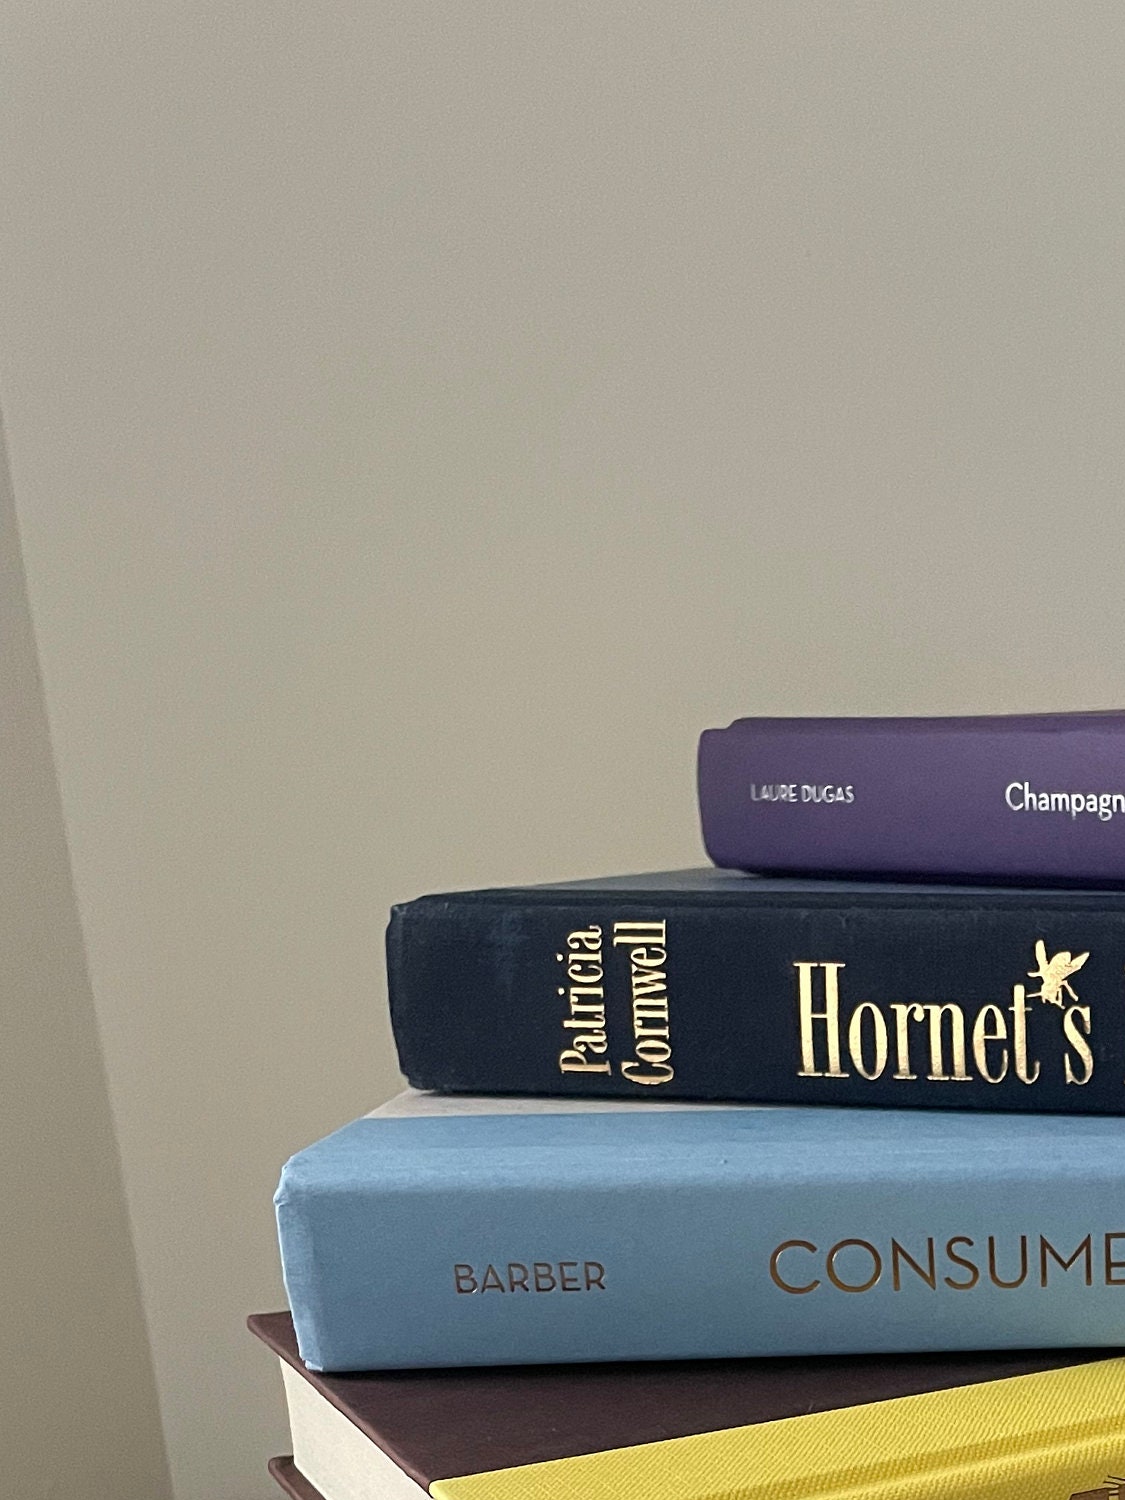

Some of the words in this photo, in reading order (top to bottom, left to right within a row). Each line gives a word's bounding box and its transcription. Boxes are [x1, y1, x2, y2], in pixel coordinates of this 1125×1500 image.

[751, 783, 798, 803] LAURE
[801, 784, 855, 804] DUGAS
[556, 924, 612, 1076] Patricia
[613, 919, 675, 1085] Cornwell
[793, 939, 1094, 1085] Hornet's
[453, 1261, 607, 1295] BARBER
